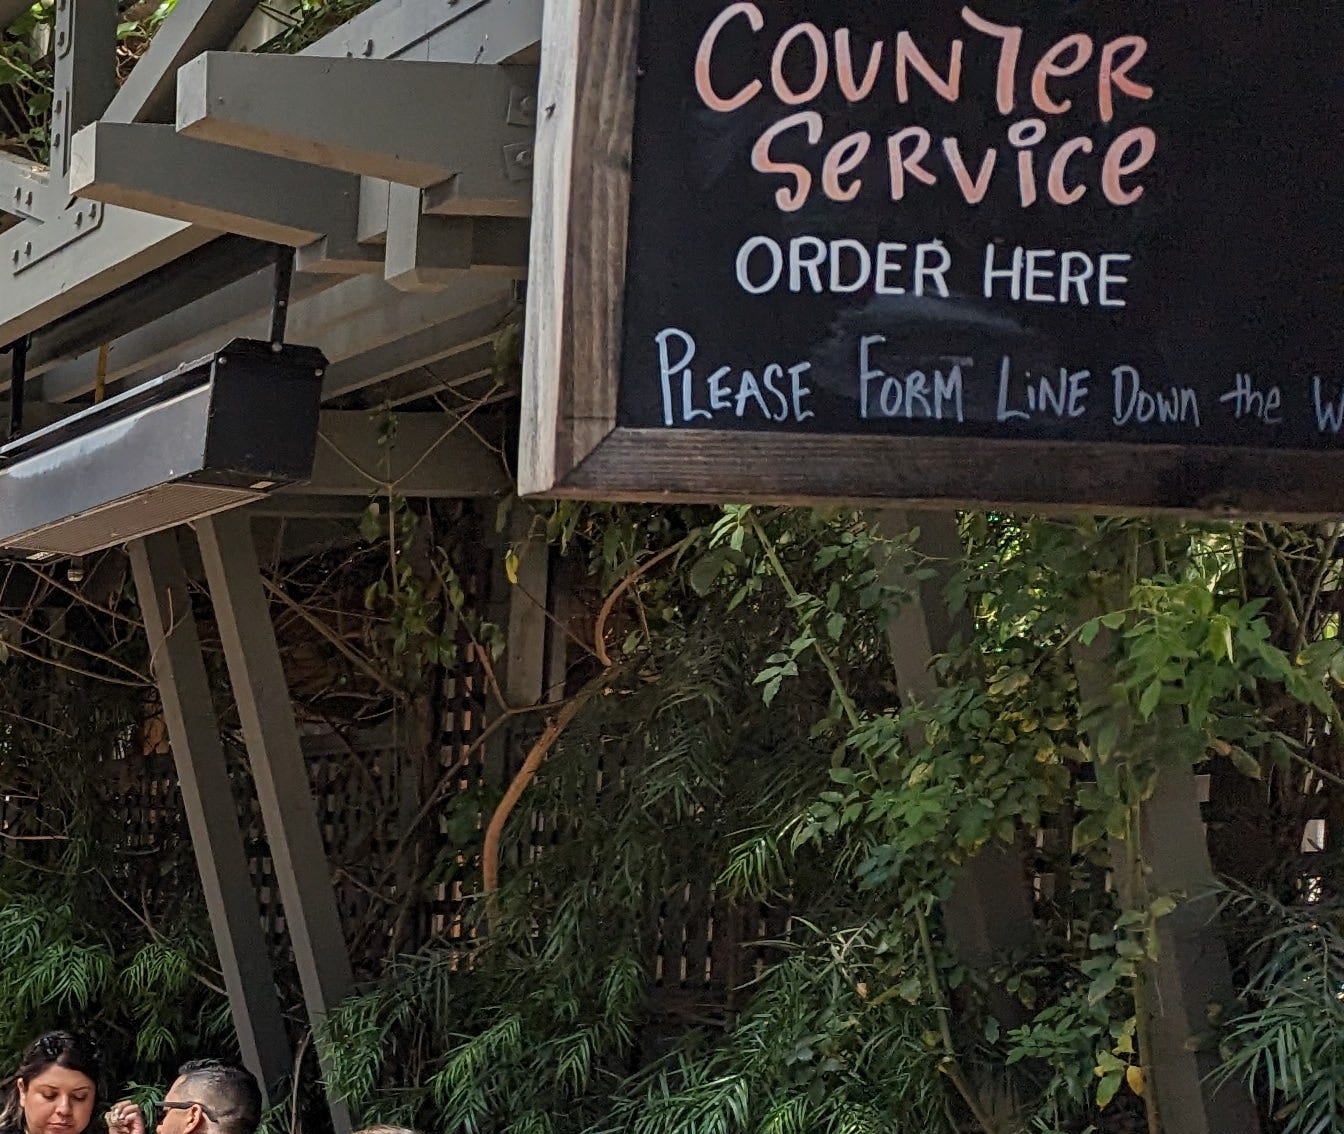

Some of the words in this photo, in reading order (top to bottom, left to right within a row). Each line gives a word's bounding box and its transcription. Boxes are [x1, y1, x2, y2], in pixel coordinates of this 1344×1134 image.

[735, 235, 952, 297] ORDER
[984, 242, 1132, 306] HERE
[655, 327, 816, 427] PLEASE
[859, 335, 965, 423] FORM
[1219, 373, 1282, 423] the
